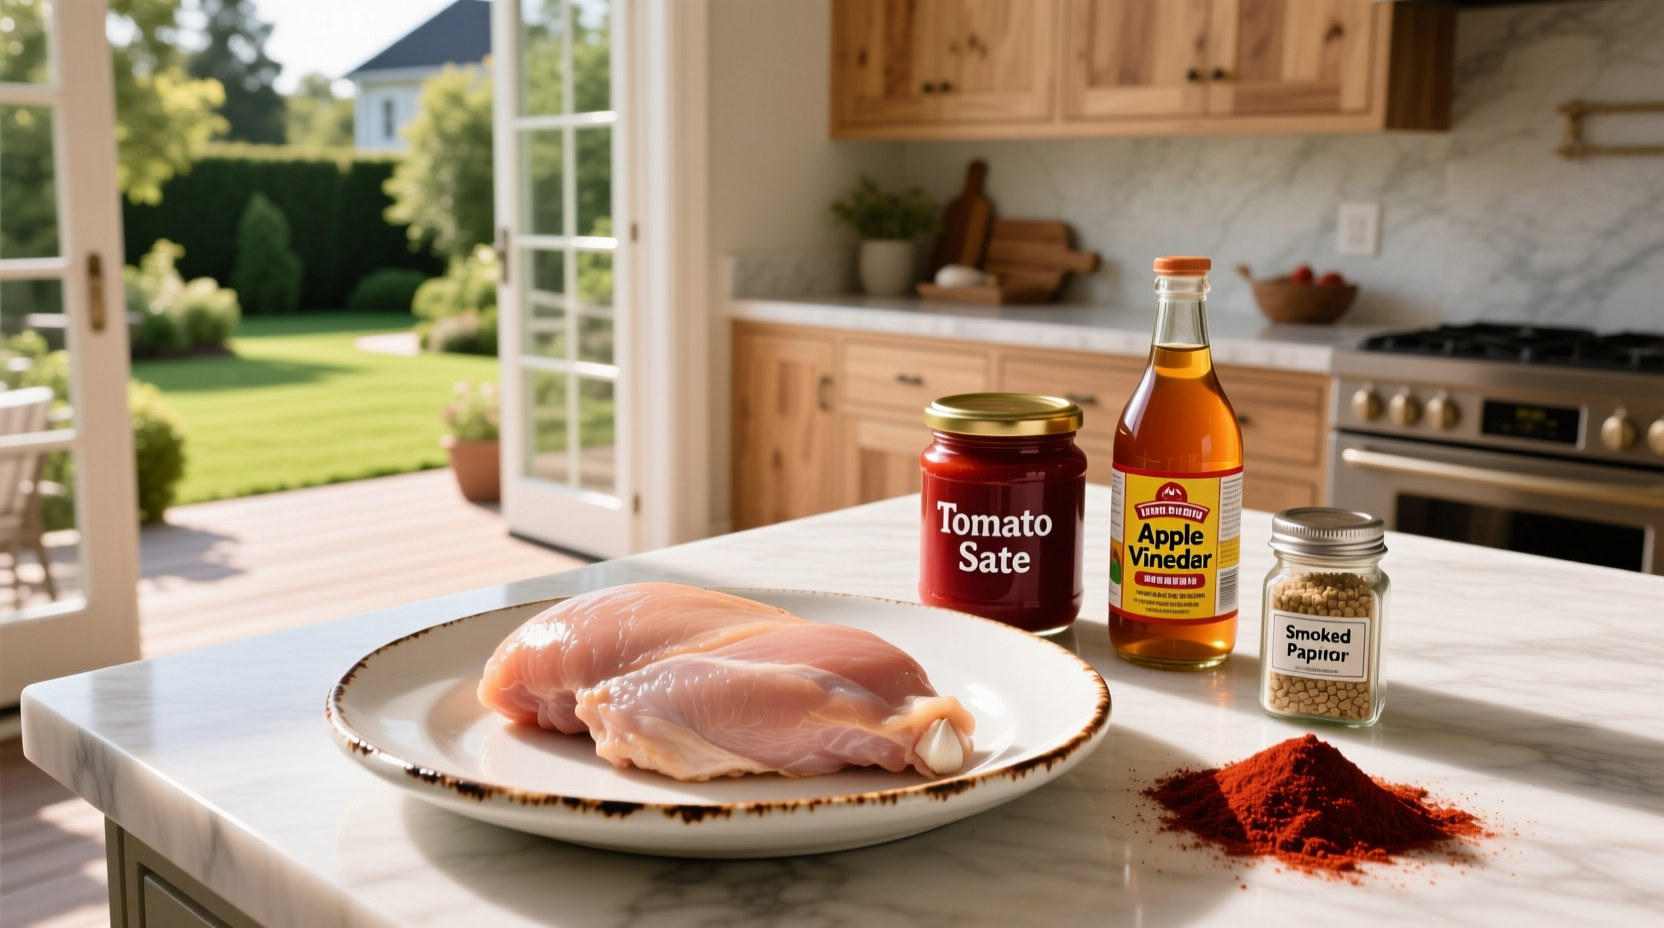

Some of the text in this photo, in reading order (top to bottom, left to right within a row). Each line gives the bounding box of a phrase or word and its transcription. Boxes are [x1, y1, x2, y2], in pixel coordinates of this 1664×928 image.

[937, 500, 1052, 537] Tomato
[1138, 523, 1204, 551] Apple
[959, 541, 1030, 574] Sate
[1128, 545, 1212, 569] Vinedar
[1286, 624, 1351, 643] Smoked
